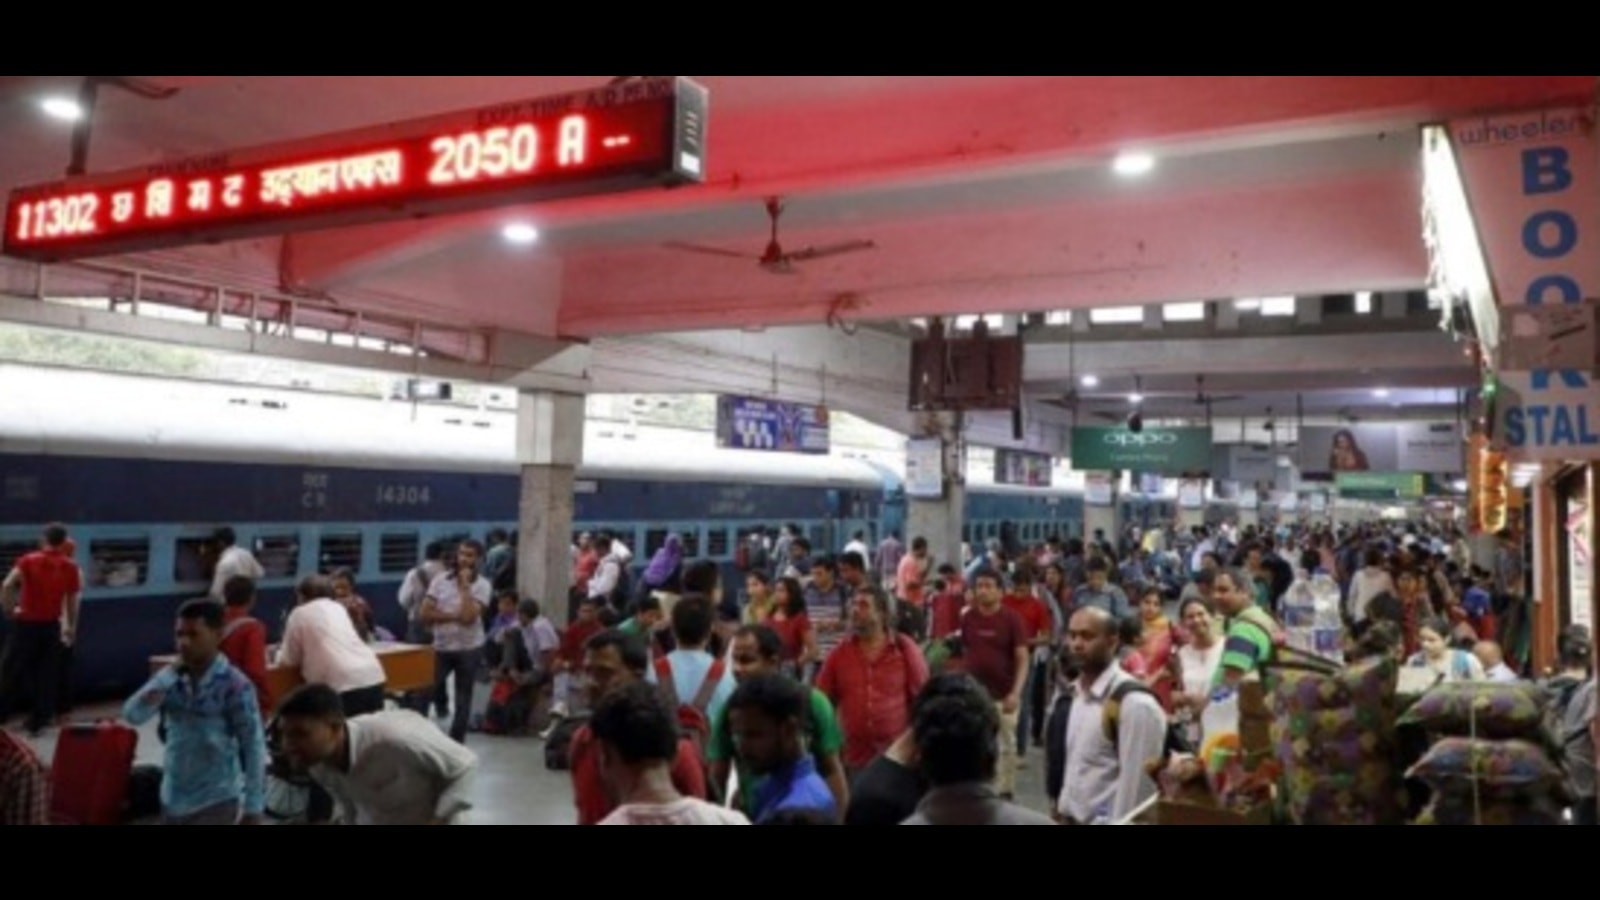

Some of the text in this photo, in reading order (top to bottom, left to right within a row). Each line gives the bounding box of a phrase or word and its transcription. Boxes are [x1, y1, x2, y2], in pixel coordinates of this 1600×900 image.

[17, 193, 99, 240] 11302
[428, 121, 538, 184] 2050
[558, 115, 587, 166] A
[1103, 433, 1179, 447] oppo
[376, 484, 431, 506] 14304
